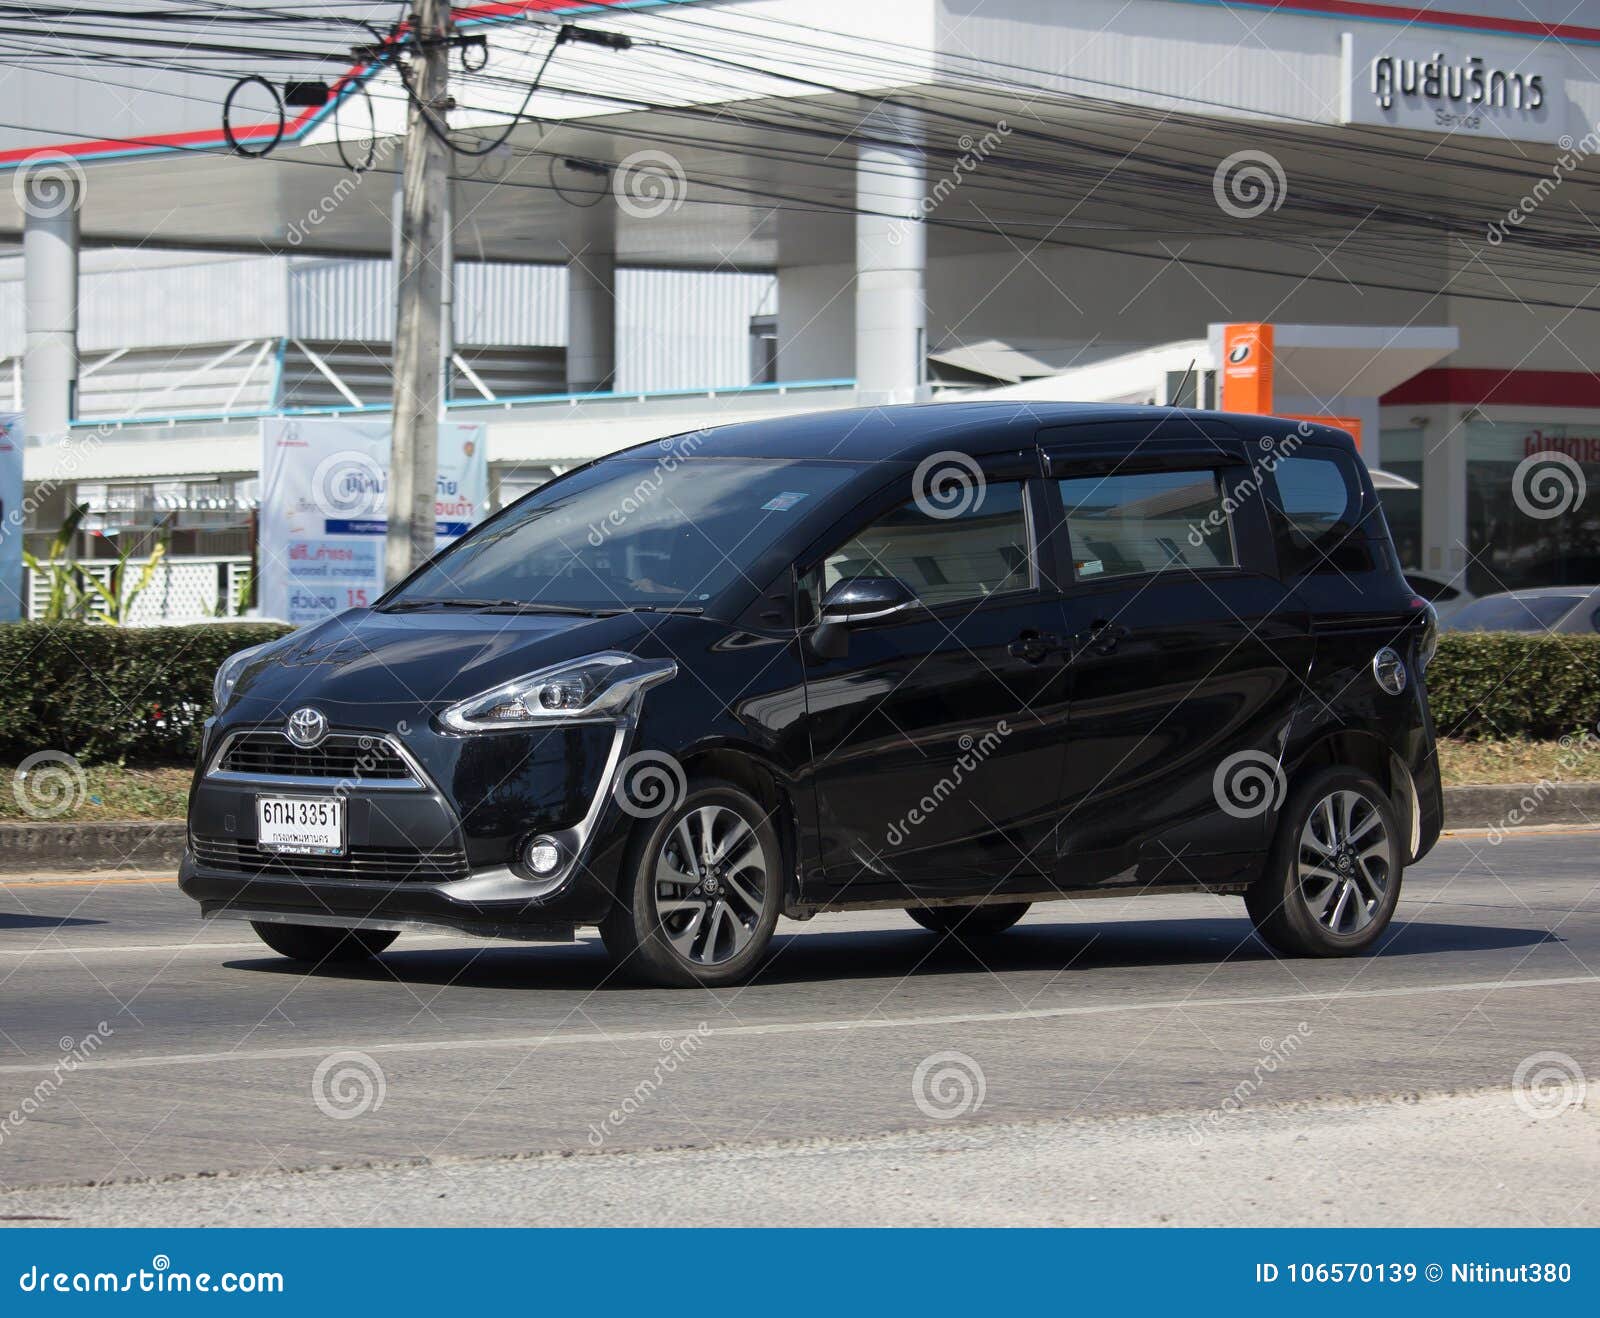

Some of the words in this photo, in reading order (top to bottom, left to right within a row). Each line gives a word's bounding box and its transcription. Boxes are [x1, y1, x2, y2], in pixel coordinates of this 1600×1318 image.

[1370, 51, 1543, 110] ศูนย์บริการ
[1435, 108, 1480, 130] Service
[299, 803, 337, 827] 3351
